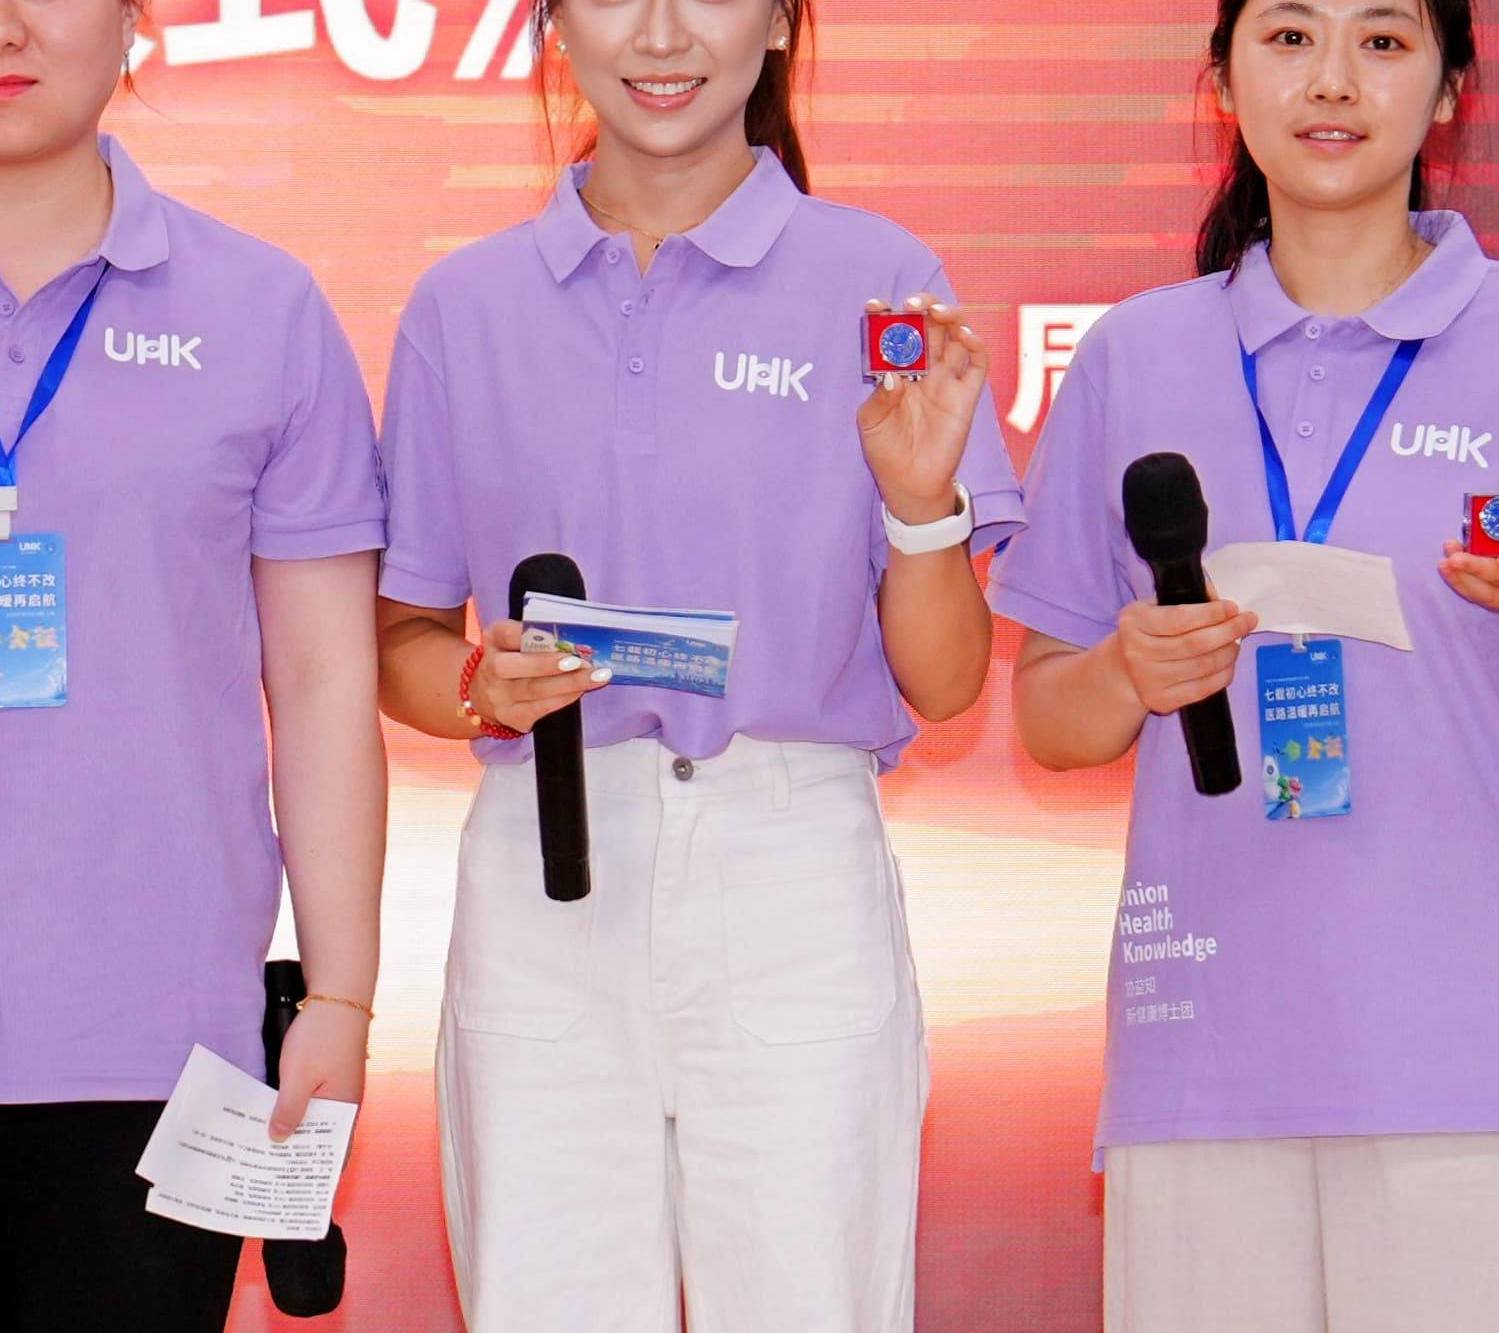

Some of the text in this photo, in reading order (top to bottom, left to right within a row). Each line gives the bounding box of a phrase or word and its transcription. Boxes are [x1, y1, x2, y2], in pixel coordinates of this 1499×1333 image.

[105, 327, 202, 370] UHK
[714, 351, 814, 402] UHK
[1390, 422, 1492, 468] UHK
[1119, 907, 1173, 935] Health
[1123, 932, 1217, 962] Knowledge
